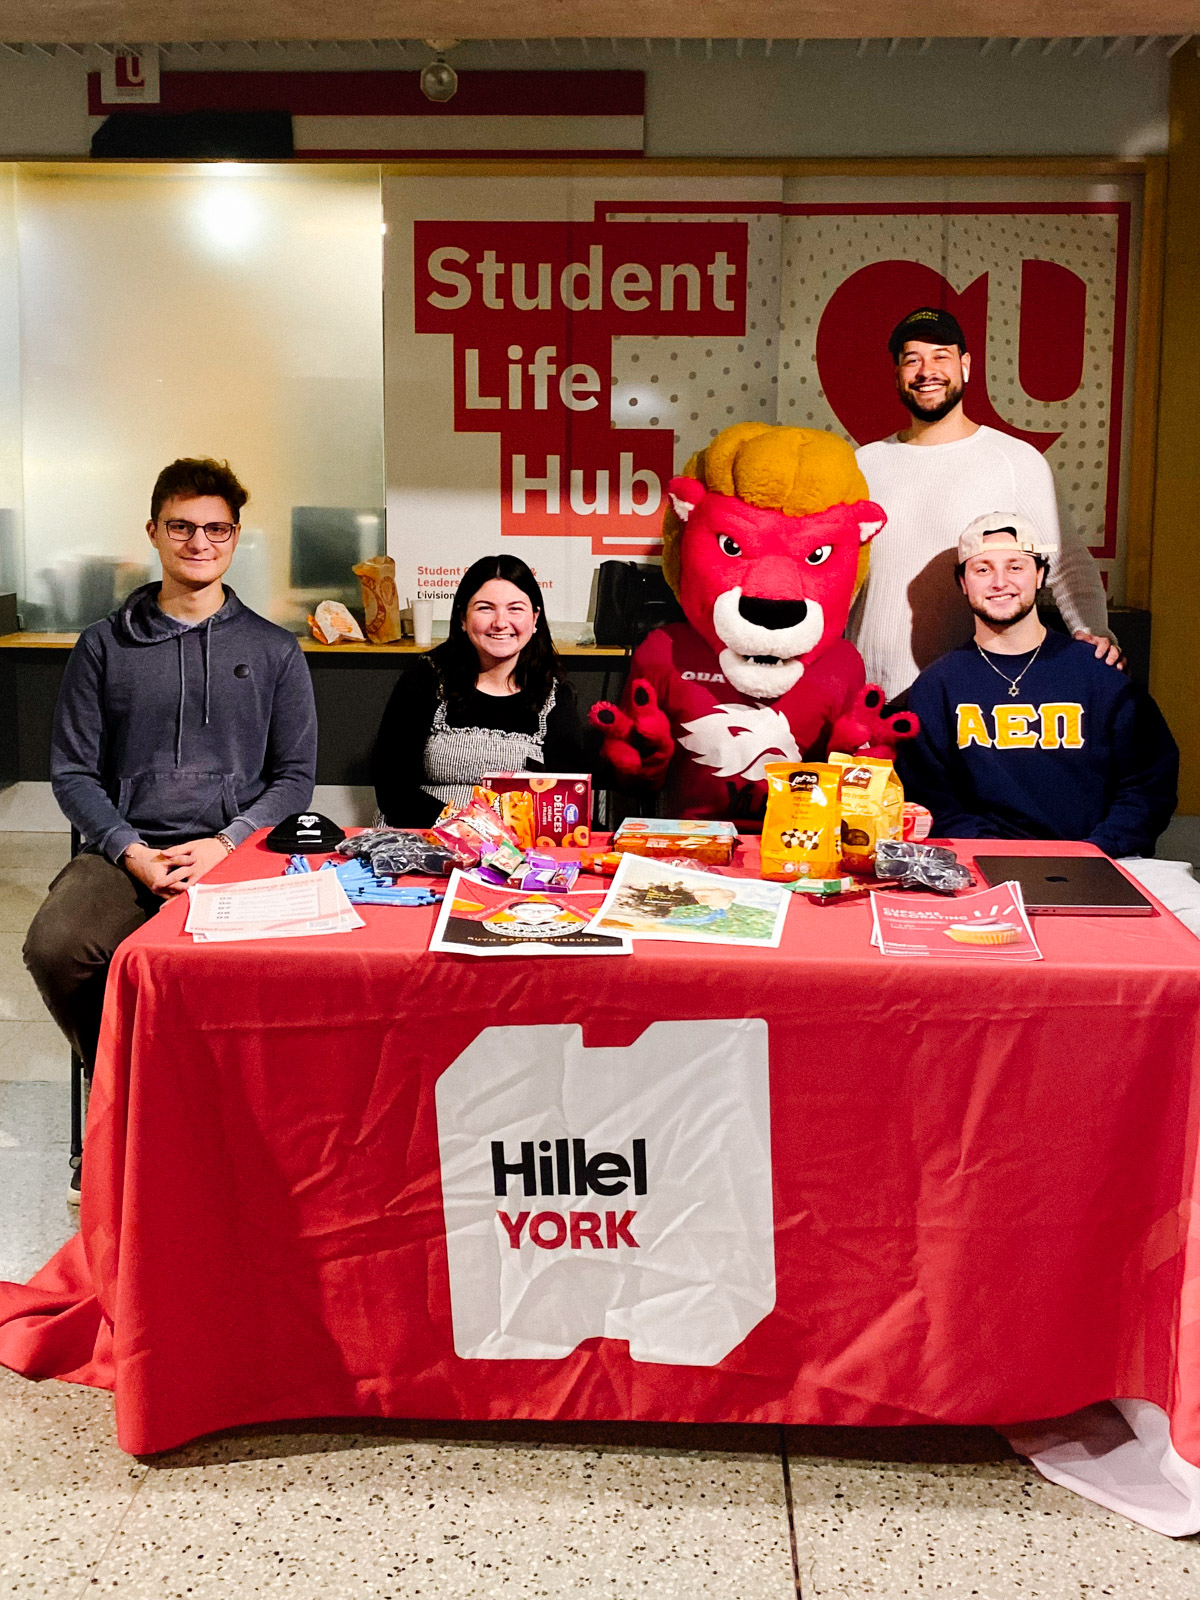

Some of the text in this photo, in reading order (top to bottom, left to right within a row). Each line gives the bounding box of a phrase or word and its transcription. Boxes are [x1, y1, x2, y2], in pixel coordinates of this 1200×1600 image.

[427, 245, 736, 311] Student
[465, 345, 601, 411] Life
[512, 452, 661, 515] Hub
[417, 566, 460, 576] Student
[417, 578, 460, 587] Leaders
[553, 794, 565, 833] DÉLICES
[883, 911, 969, 921] DECORATING
[490, 1138, 648, 1197] Hillel
[496, 1210, 641, 1250] YORK
